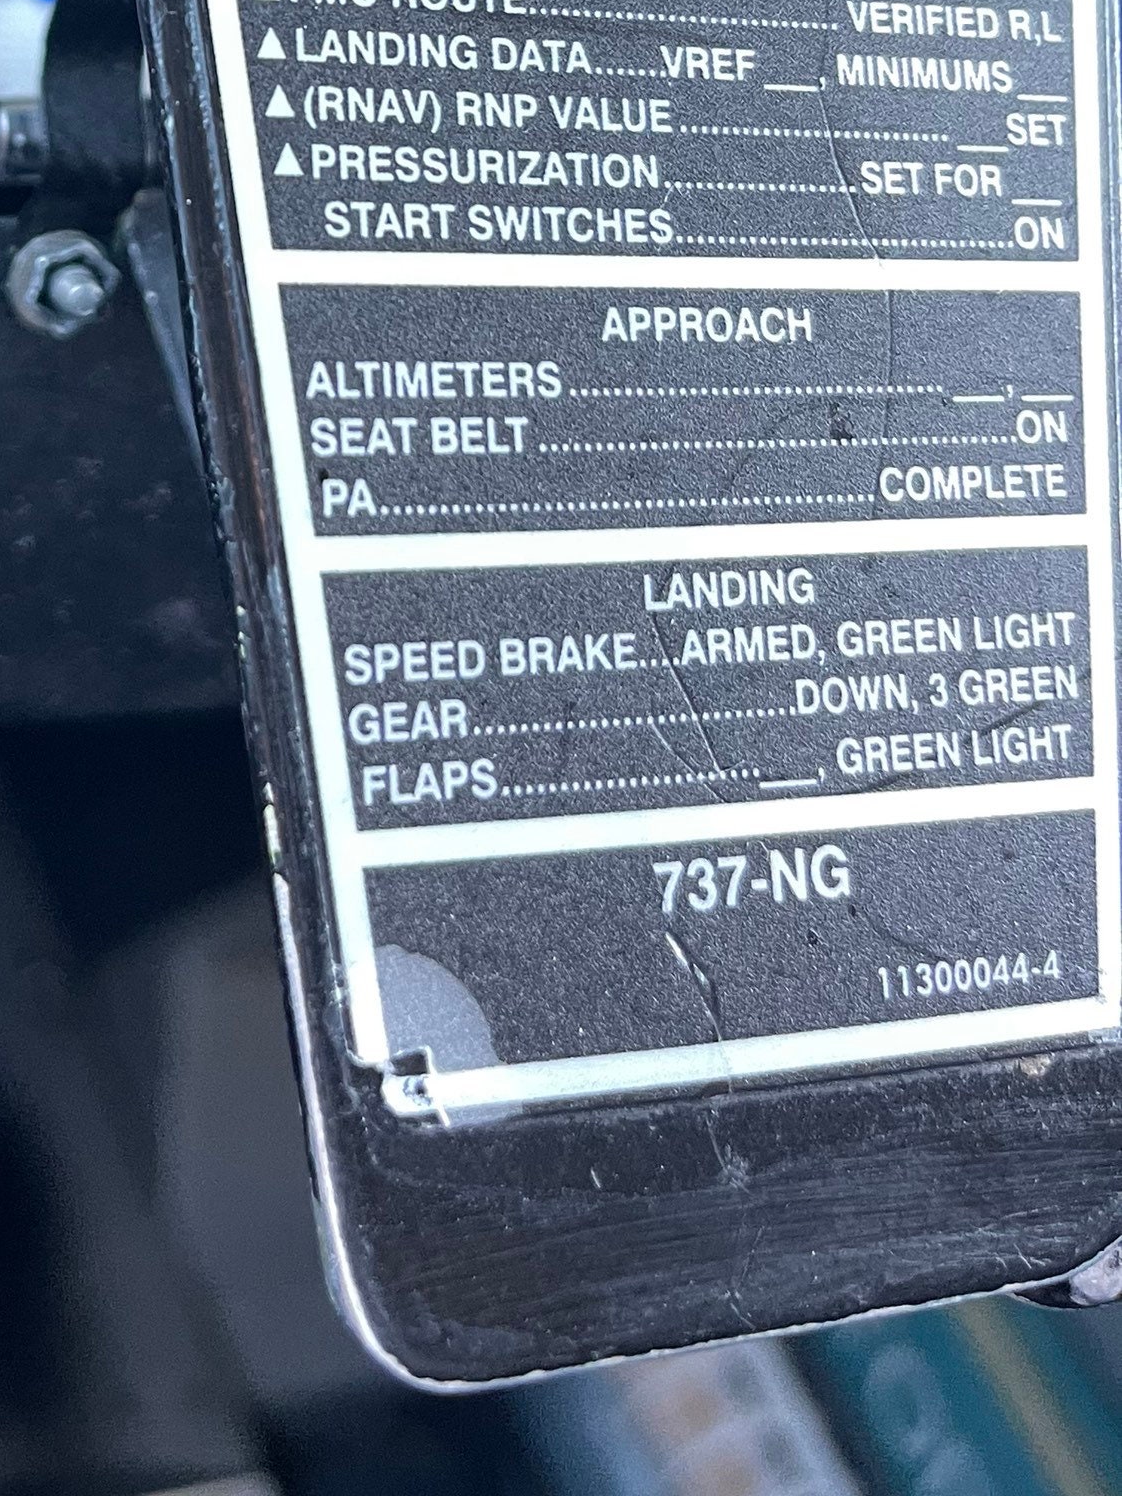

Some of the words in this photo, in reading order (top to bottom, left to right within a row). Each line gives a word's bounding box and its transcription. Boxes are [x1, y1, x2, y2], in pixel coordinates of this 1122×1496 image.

[847, 0, 1000, 40] VERIFIED
[295, 27, 479, 71] LANDING
[491, 37, 593, 75] DATA
[662, 45, 756, 82] VREF
[836, 53, 1014, 94] MINIMUMS
[303, 85, 442, 134] (RNAV)
[455, 91, 538, 128] RNP
[548, 94, 674, 134] VALUE
[311, 143, 659, 189] PRESSURIZATION
[860, 160, 927, 197] SET
[933, 162, 1008, 199] FOR
[324, 200, 457, 240] START
[467, 204, 675, 246] SWITCHES
[1013, 215, 1070, 251] ON
[601, 306, 813, 346] APPROACH
[305, 360, 563, 399] ALTIMETERS
[310, 417, 418, 458] SEAT
[430, 415, 529, 455] BELT
[1015, 409, 1070, 445] ON
[322, 478, 377, 518] PA
[879, 463, 1069, 503] COMPLETE
[643, 567, 816, 612] LANDING
[344, 639, 486, 686] SPEED
[499, 632, 638, 677] BRAKE
[681, 622, 827, 667] ARMED,
[836, 617, 965, 659] GREEN
[973, 611, 1077, 651] LIGHT
[348, 698, 469, 745] GEAR
[795, 673, 920, 716] DOWN,
[928, 672, 949, 710] 3
[957, 664, 1080, 707] GREEN
[362, 757, 498, 806] FLAPS
[835, 731, 962, 780] GREEN
[971, 723, 1074, 767] LIGHT
[653, 842, 852, 915] 737-NG
[877, 949, 1064, 1000] 11300044-4
